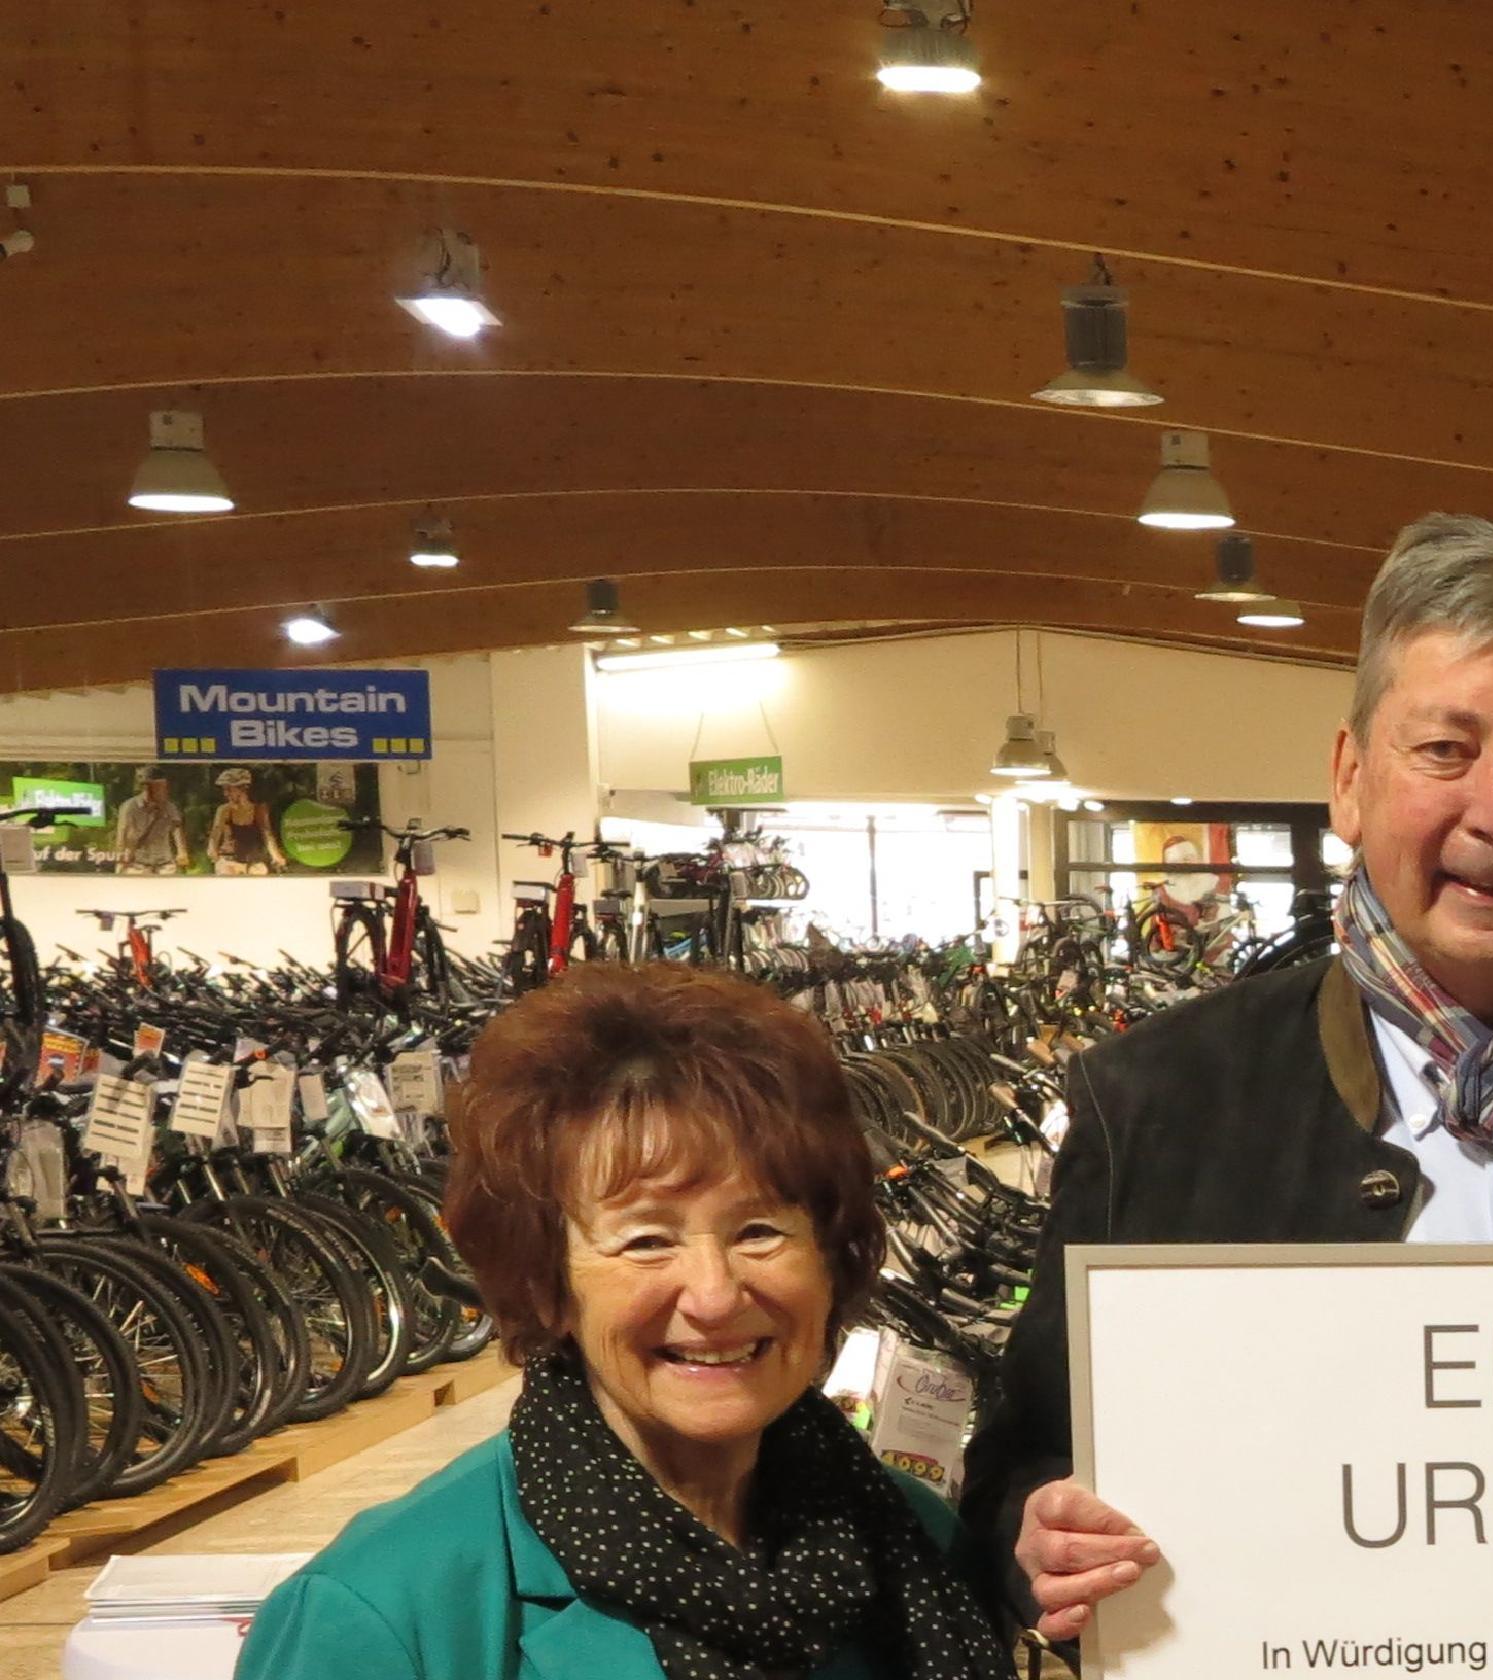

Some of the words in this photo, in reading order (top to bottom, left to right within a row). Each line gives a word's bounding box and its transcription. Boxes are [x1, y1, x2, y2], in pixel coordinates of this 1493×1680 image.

[179, 685, 406, 713] Mountain
[231, 720, 358, 748] Bikes
[54, 846, 82, 861] der
[1262, 1641, 1291, 1669] In
[1302, 1637, 1486, 1673] Würdigung
